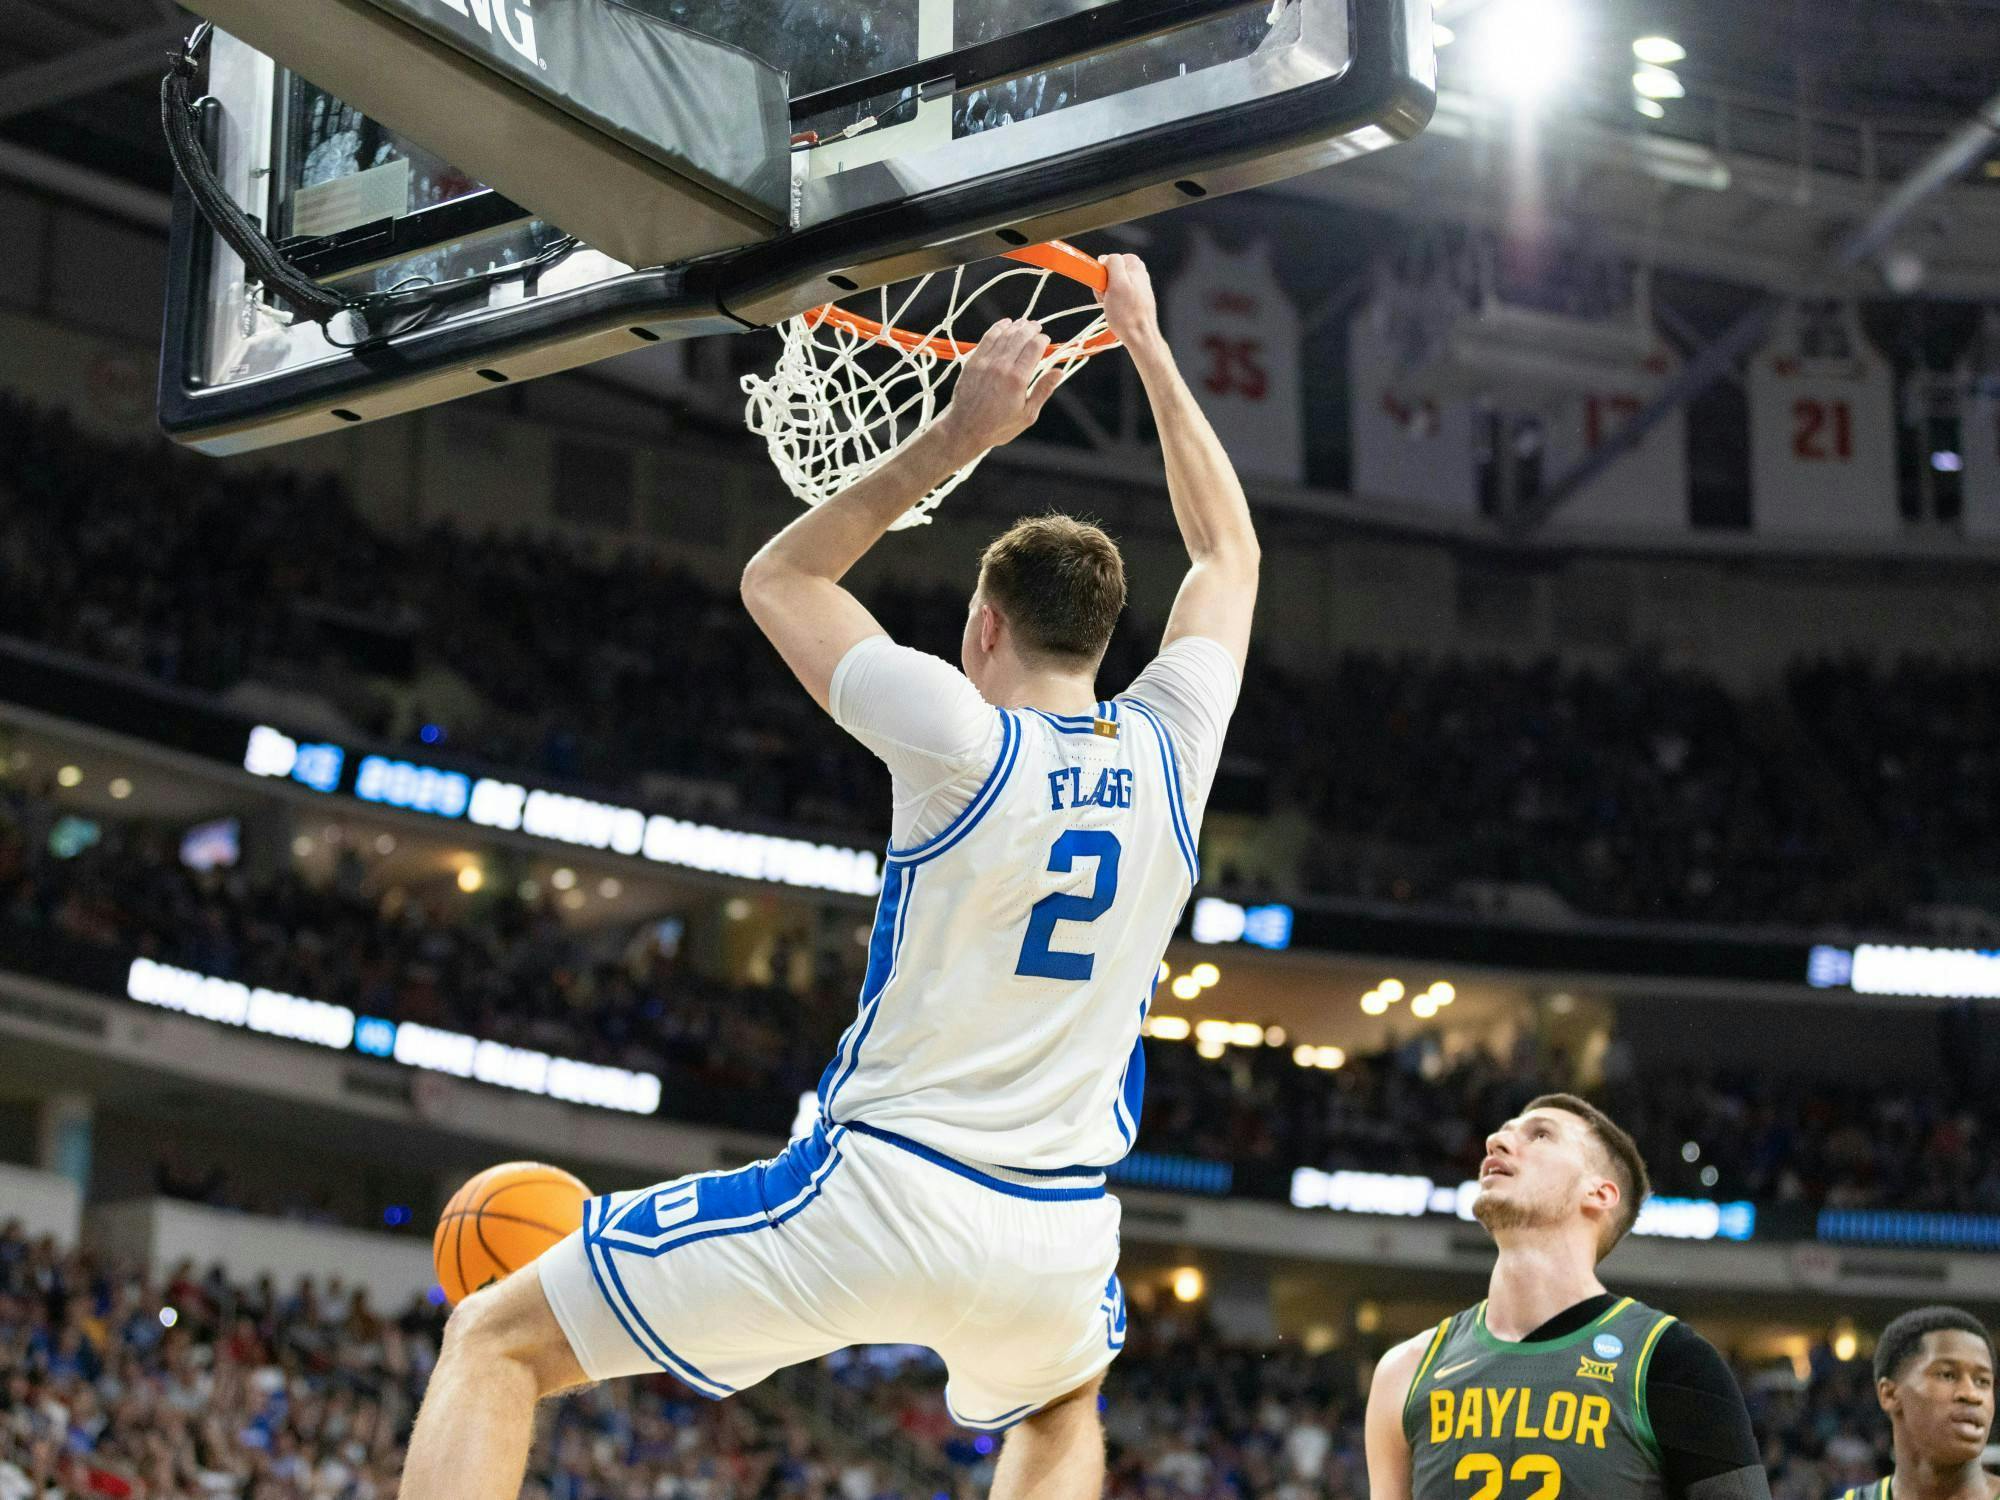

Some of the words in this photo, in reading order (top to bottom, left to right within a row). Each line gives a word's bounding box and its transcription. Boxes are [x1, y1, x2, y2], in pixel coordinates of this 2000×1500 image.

[1794, 397, 1853, 463] 21
[1047, 767, 1133, 811] FLAGG
[1014, 829, 1122, 980] 2
[1429, 1387, 1611, 1449] BAYLOR
[1454, 1453, 1562, 1500] 22
